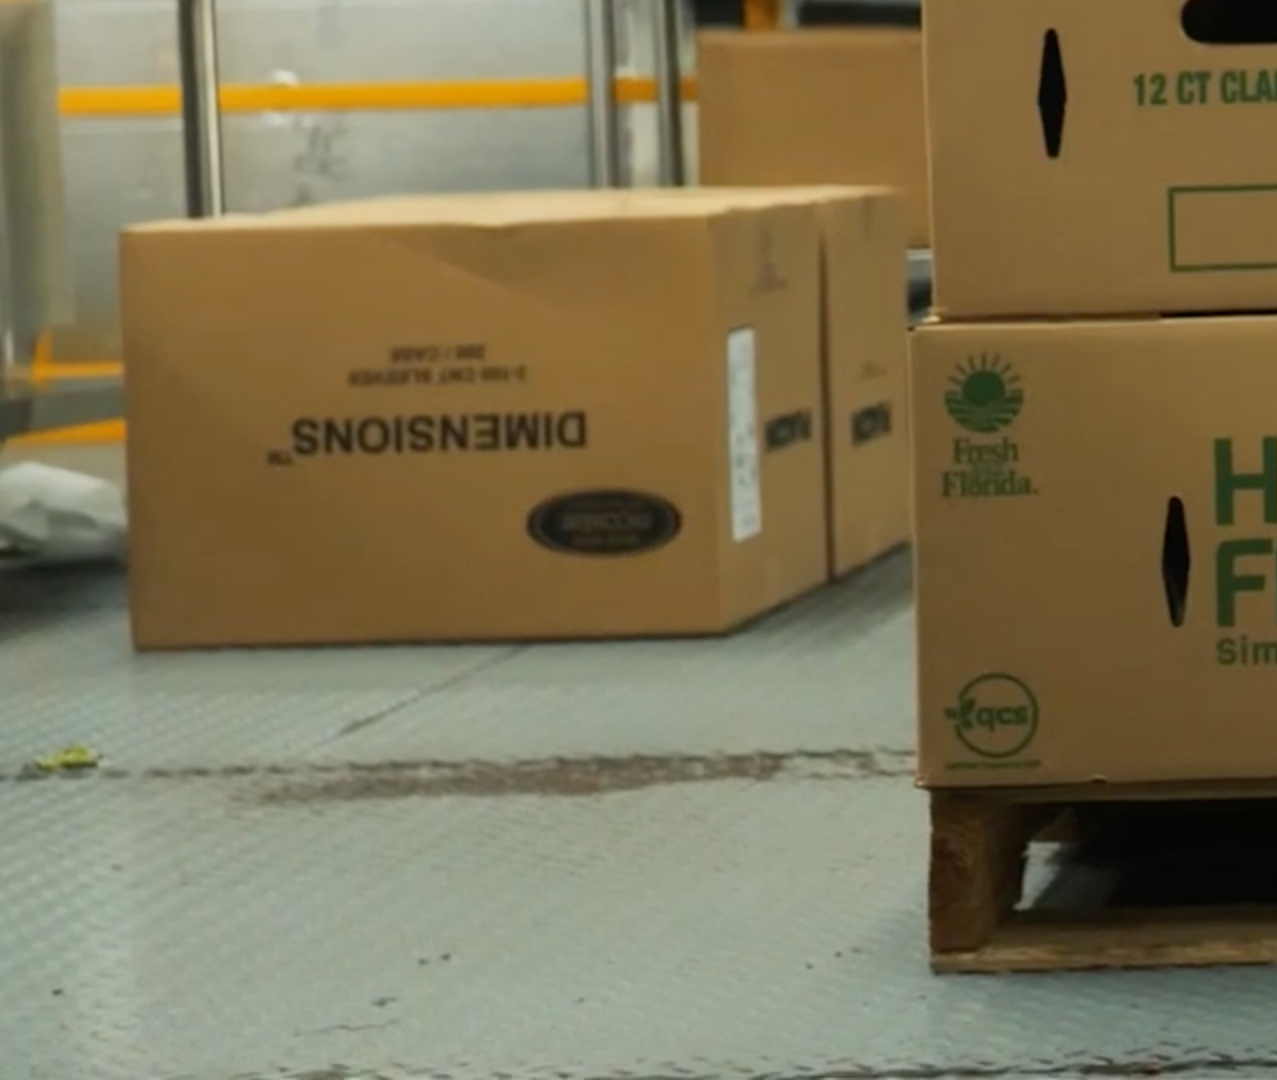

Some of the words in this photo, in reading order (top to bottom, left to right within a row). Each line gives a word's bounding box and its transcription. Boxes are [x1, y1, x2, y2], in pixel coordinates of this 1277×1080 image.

[1134, 74, 1166, 105] 12
[1176, 71, 1210, 104] CT
[953, 437, 1018, 464] Fresh
[976, 706, 1029, 732] qcs
